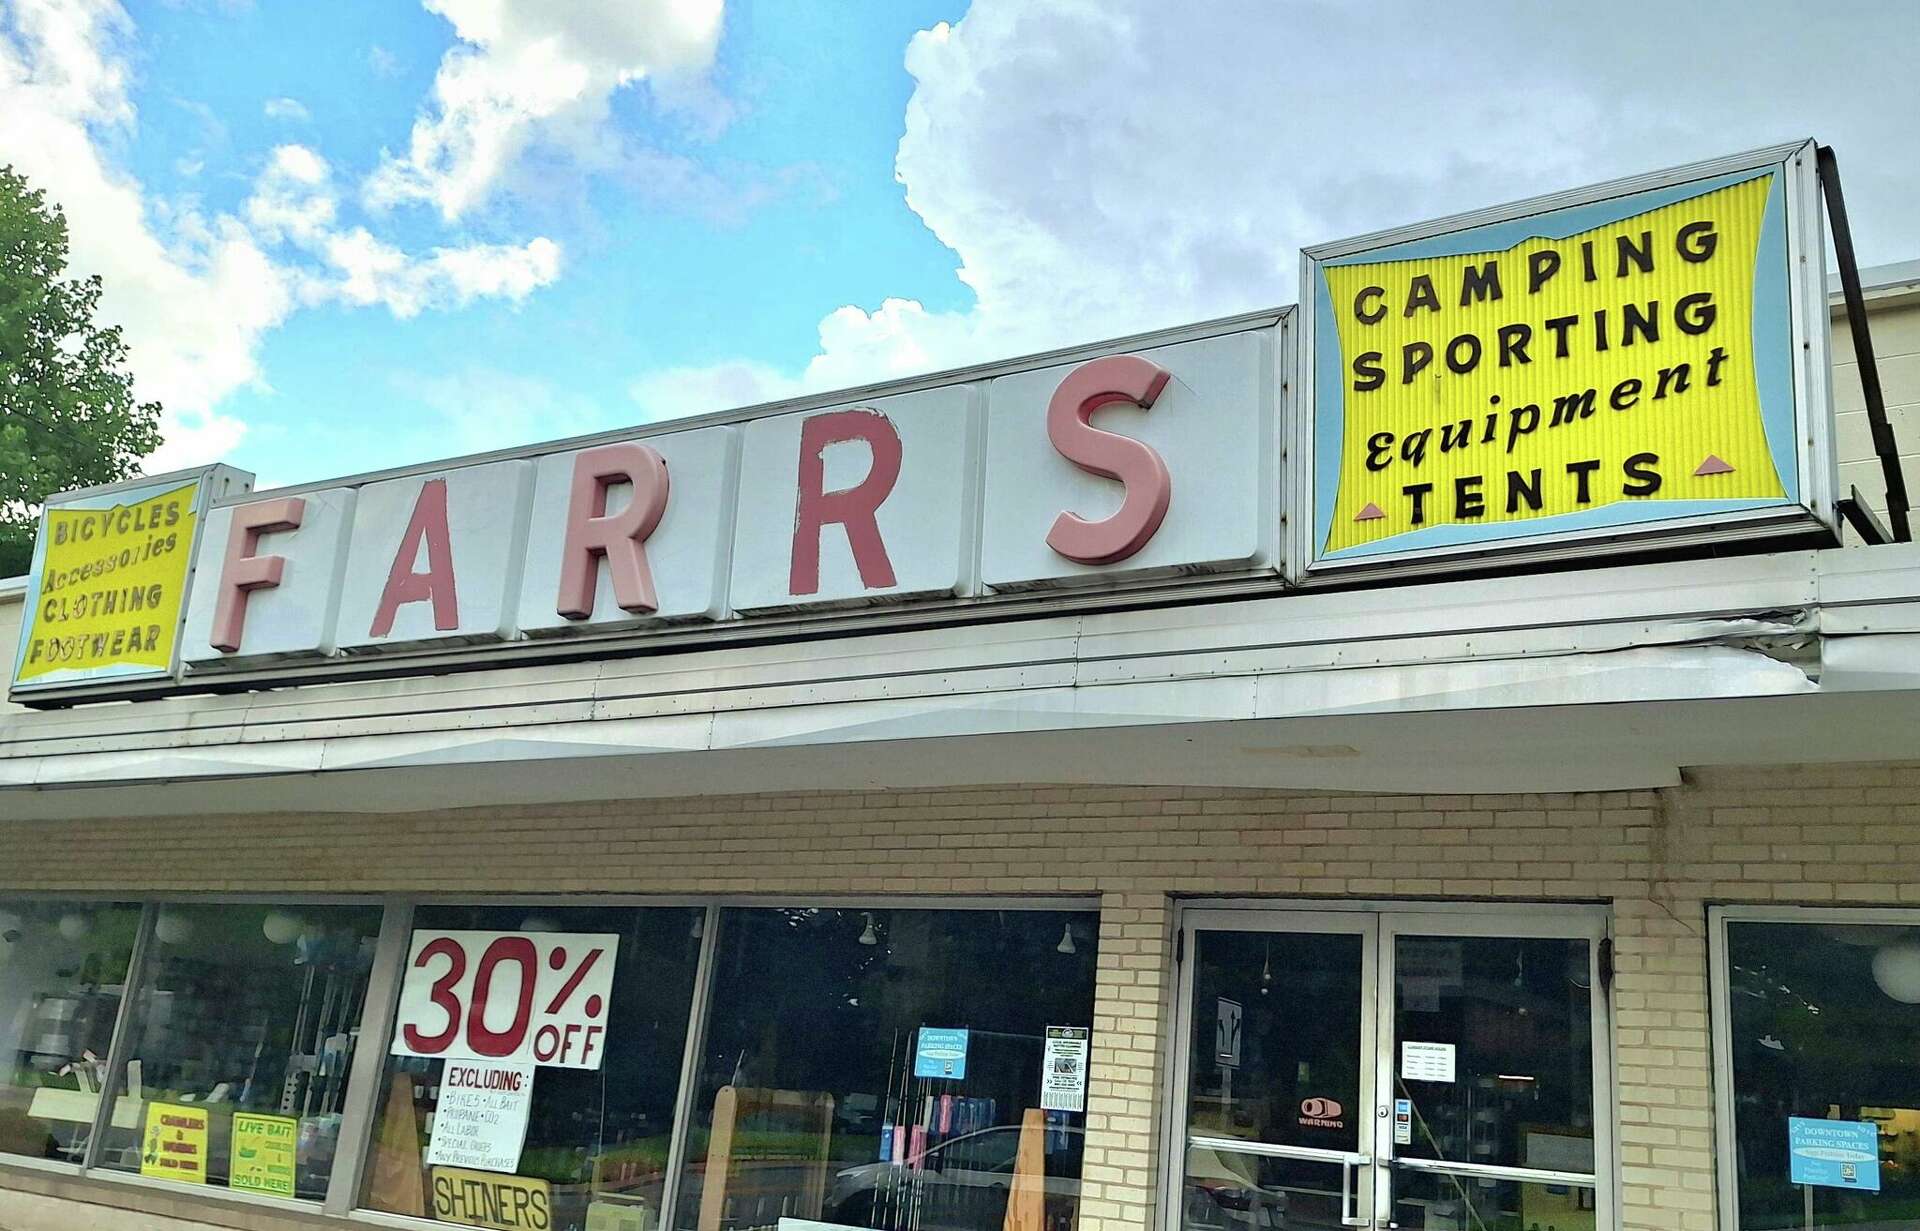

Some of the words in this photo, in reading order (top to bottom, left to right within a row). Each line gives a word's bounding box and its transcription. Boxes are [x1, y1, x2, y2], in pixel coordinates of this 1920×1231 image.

[1353, 221, 1718, 325] CAMPING
[1352, 292, 1717, 392] SPORTING
[1365, 347, 1729, 473] Equipment
[209, 354, 1172, 653] FARRS
[1402, 452, 1664, 524] TENTS
[54, 501, 181, 546] BICYCLES
[43, 584, 162, 623] CLOTHING
[29, 624, 161, 664] FOOTWEAR
[403, 936, 605, 1057] 30%
[533, 1024, 603, 1065] OFF
[238, 1120, 264, 1136] LIVE
[267, 1123, 292, 1138] BAIT
[1298, 1117, 1344, 1129] WARNING
[1795, 1137, 1835, 1147] PARKING
[1836, 1140, 1870, 1150] SPACES
[1804, 1127, 1859, 1139] DOWNTOWN
[234, 1174, 261, 1187] SOLD
[264, 1177, 290, 1191] HERE
[434, 1175, 549, 1231] SHINERS
